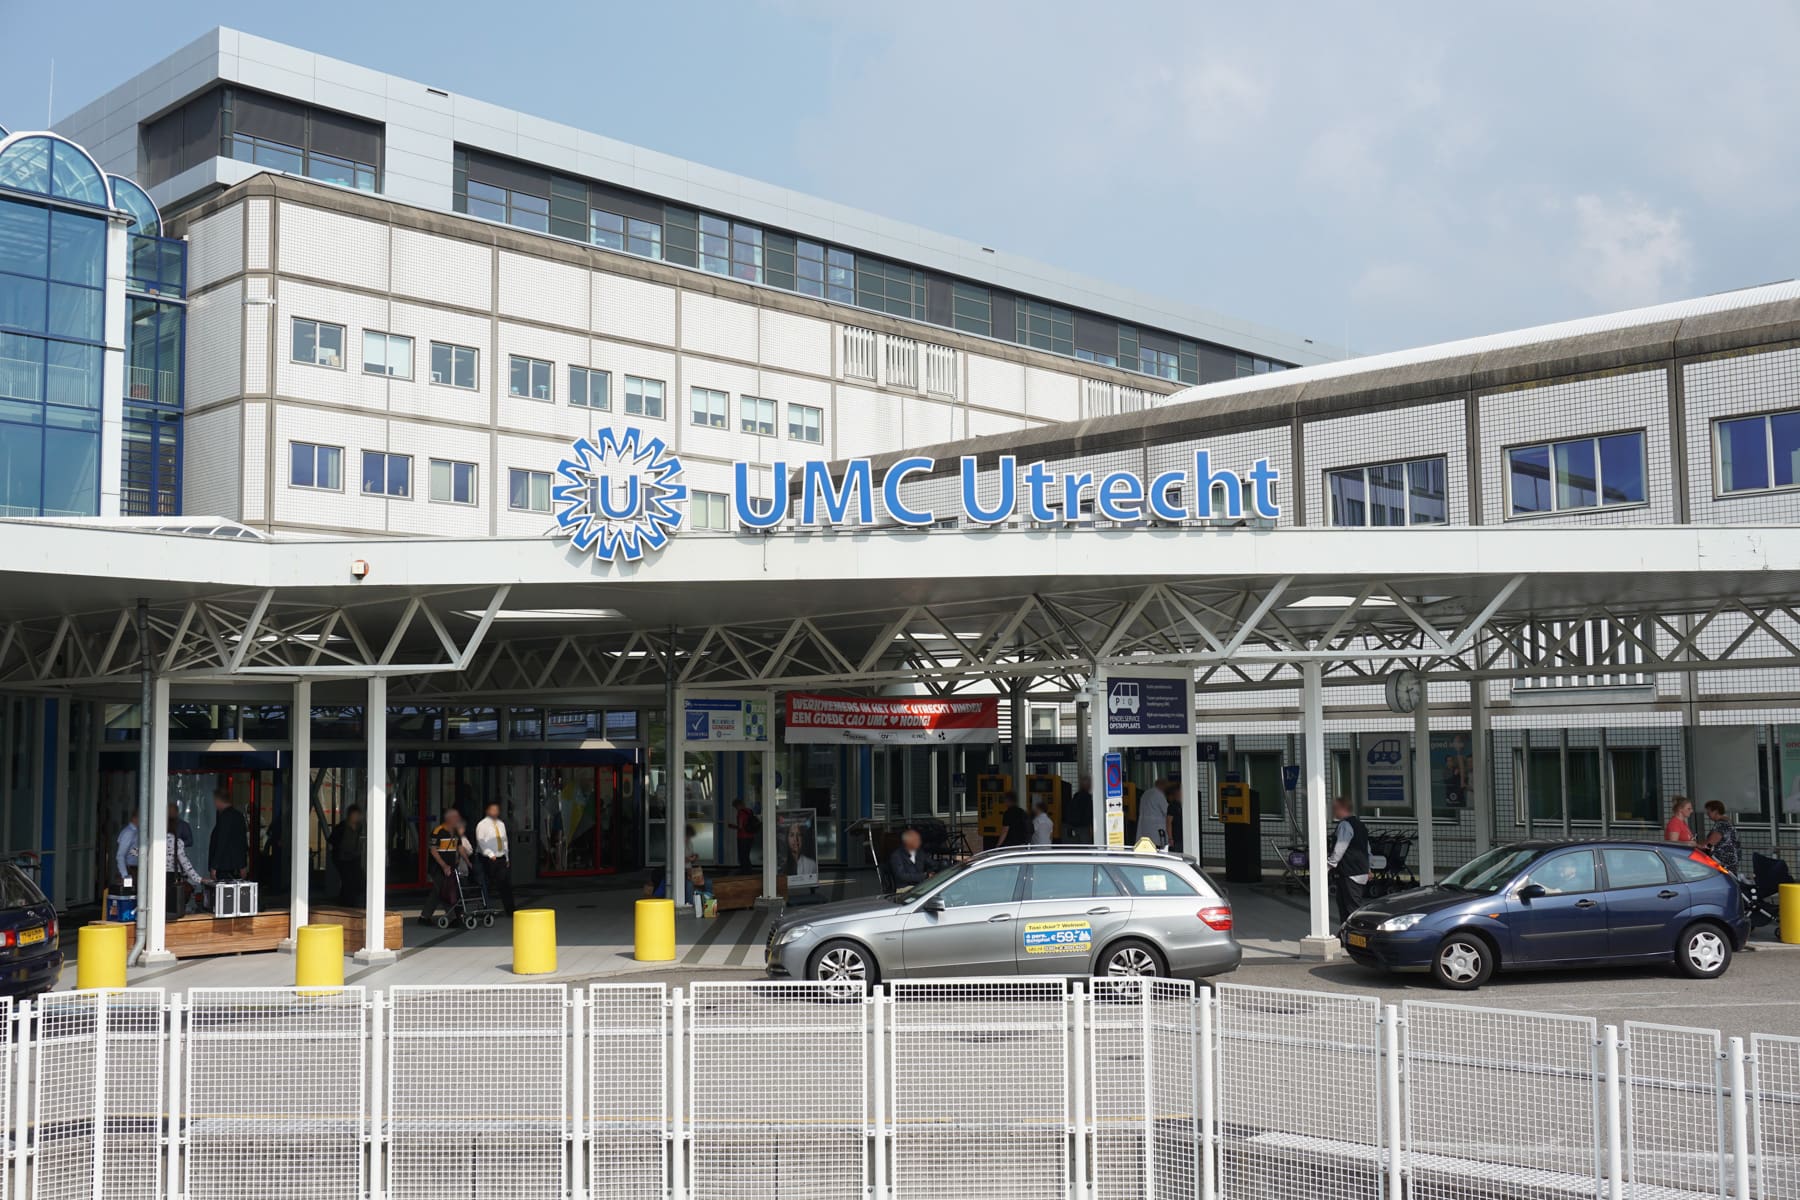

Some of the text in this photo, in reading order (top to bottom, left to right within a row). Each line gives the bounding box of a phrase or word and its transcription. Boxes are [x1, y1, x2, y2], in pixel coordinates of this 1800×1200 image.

[599, 474, 639, 520] U
[733, 448, 1282, 528] UMC Utrecht
[792, 711, 931, 727] EEN GOEDE CAO UMC NODIG!
[871, 703, 889, 713] HET
[890, 704, 910, 713] UMC
[911, 704, 950, 713] UTRECHT
[950, 703, 982, 713] VINDEN
